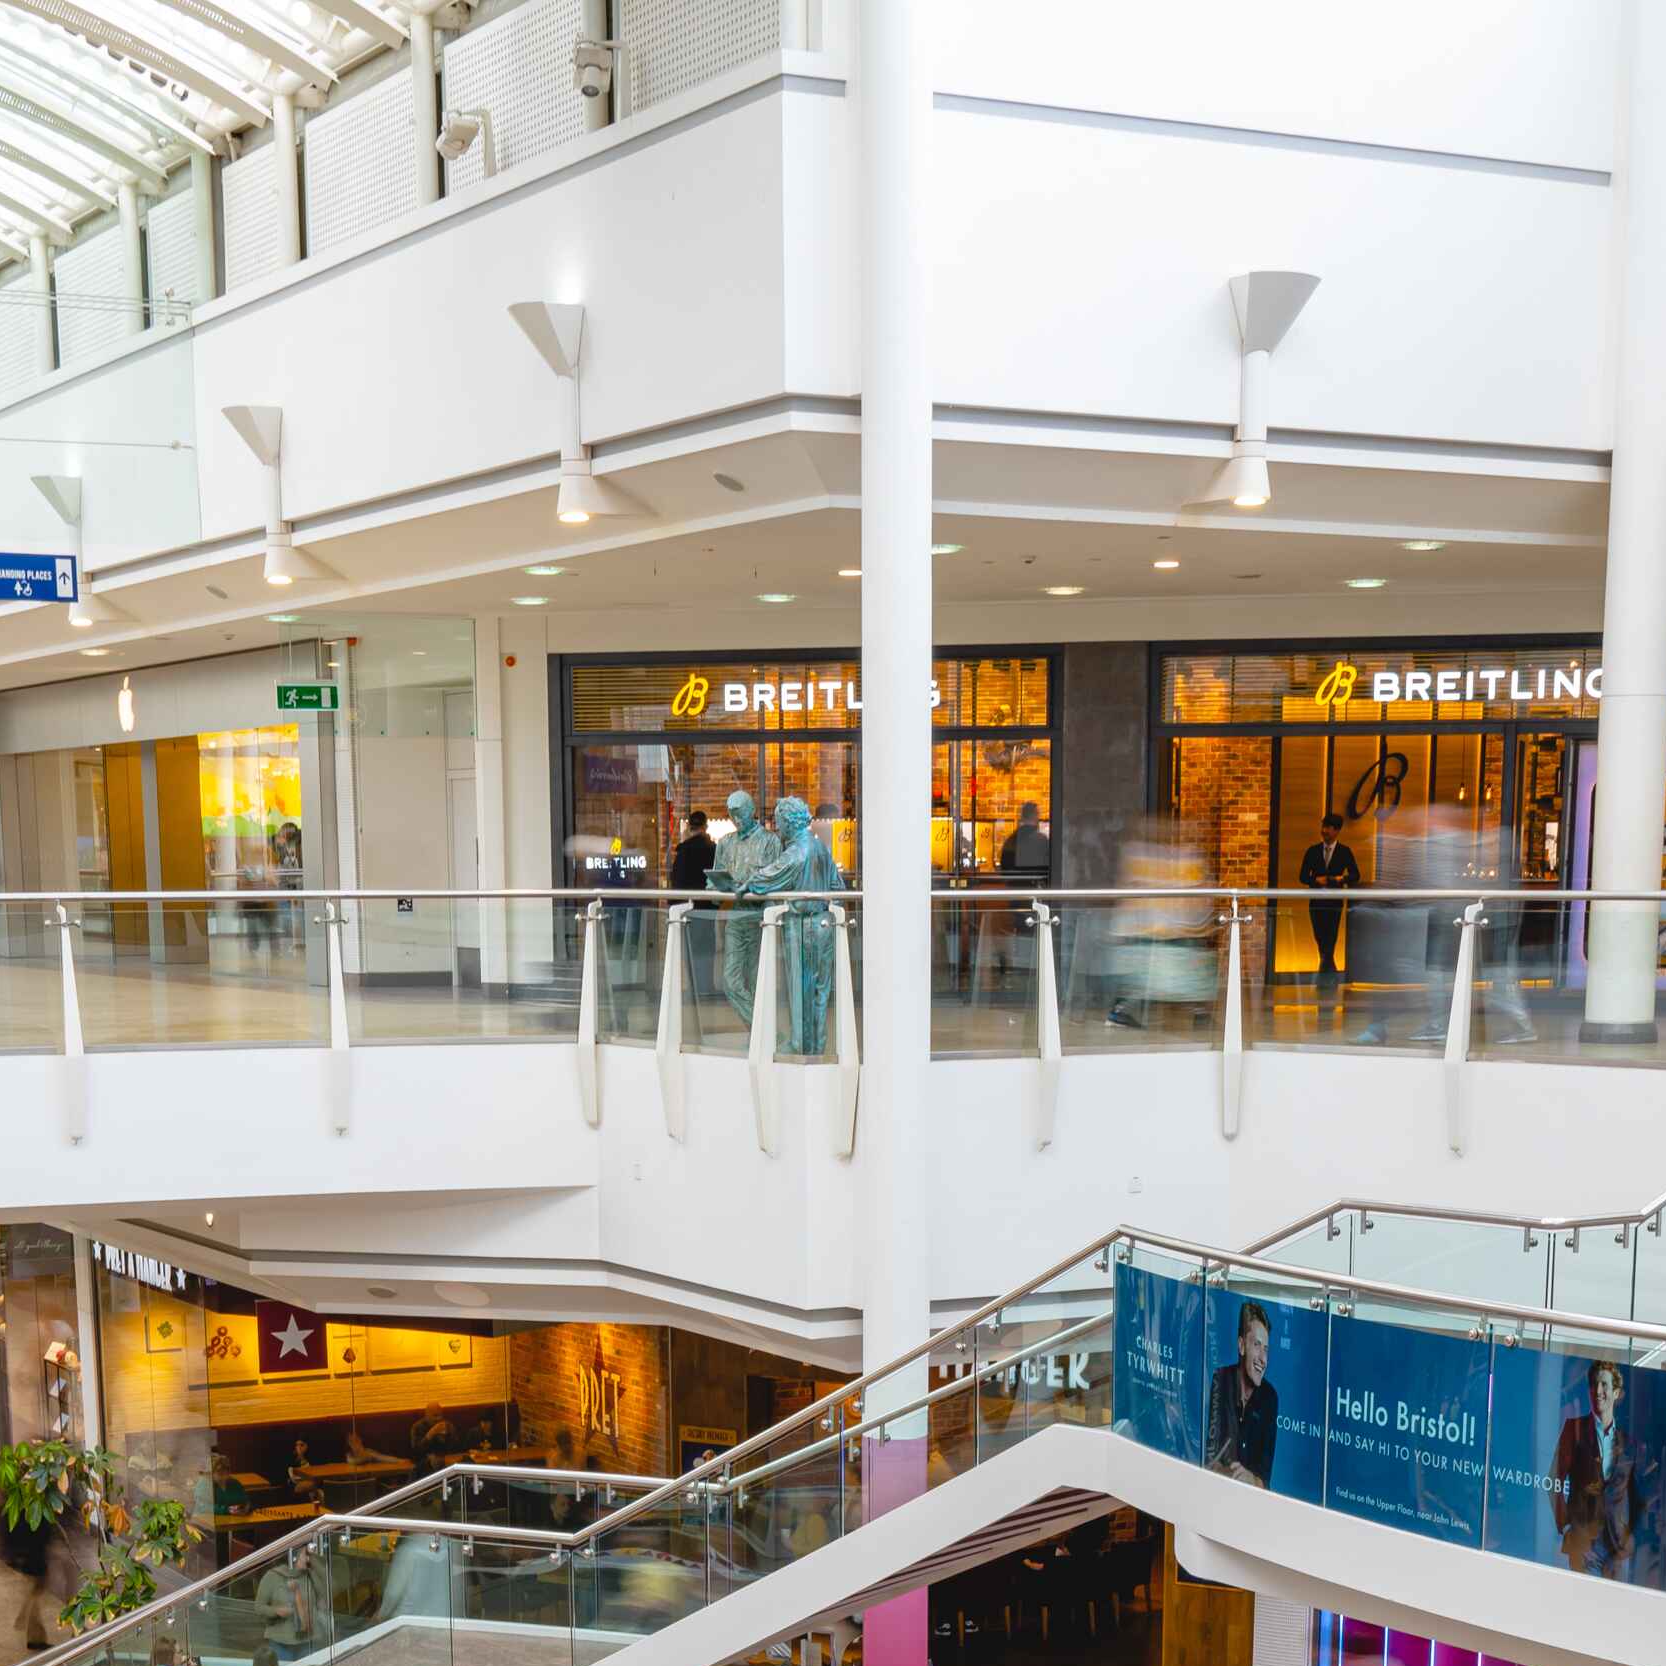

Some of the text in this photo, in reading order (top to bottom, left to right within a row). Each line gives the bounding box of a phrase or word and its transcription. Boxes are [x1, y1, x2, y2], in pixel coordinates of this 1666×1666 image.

[27, 570, 52, 581] PLACES
[1136, 1335, 1173, 1359] CHARLES
[1127, 1351, 1184, 1385] TYRWHITT
[579, 1363, 621, 1438] PRET
[1336, 1386, 1476, 1446] Hello Bristol!
[1276, 1414, 1571, 1495] COME IN AND SAY HI TO YOUR NEW WARDROBE
[1335, 1486, 1348, 1498] Find
[1366, 1495, 1375, 1506] the
[1376, 1497, 1396, 1512] Upper
[1397, 1503, 1415, 1518] Floor,
[1417, 1510, 1432, 1521] near
[1433, 1512, 1450, 1525] John
